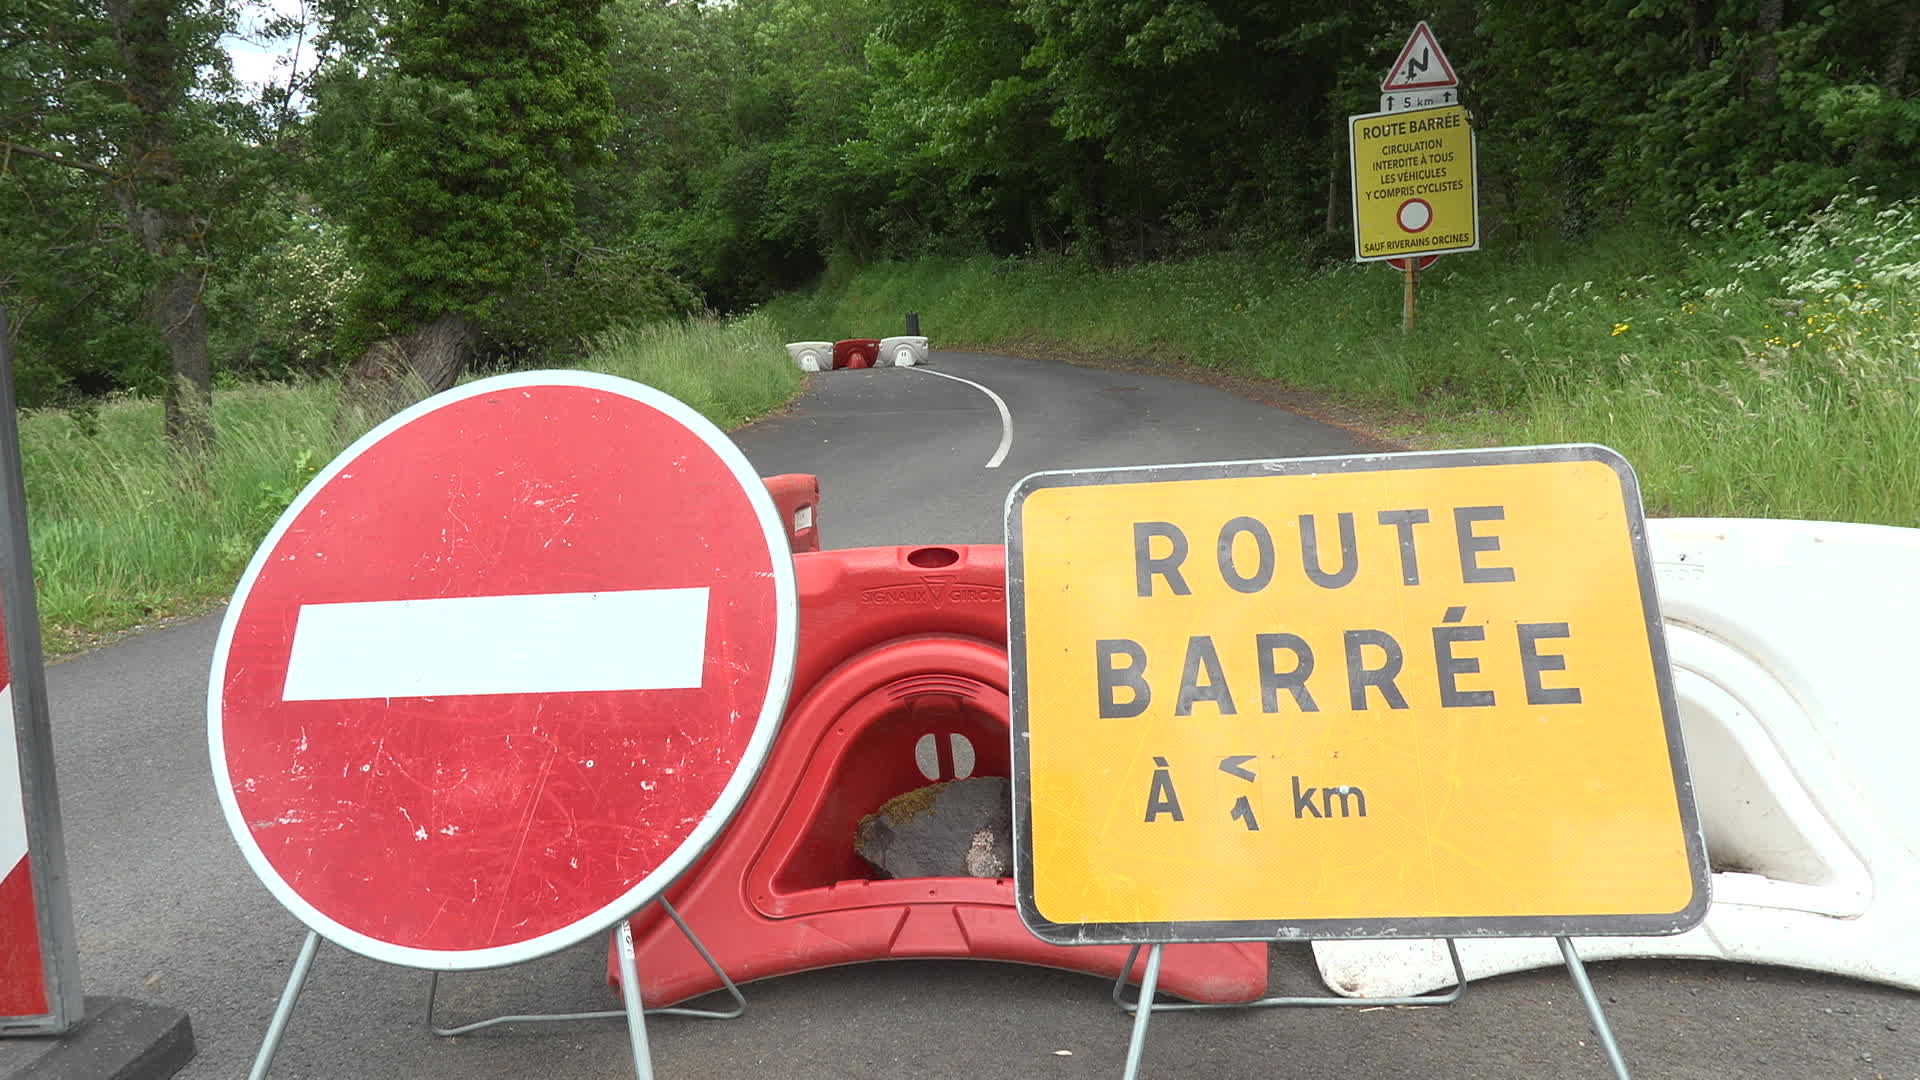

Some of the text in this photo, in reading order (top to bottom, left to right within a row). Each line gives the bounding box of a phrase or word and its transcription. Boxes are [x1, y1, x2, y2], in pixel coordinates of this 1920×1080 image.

[1403, 96, 1434, 109] 5 km
[1363, 111, 1461, 140] ROUTE BARRÉE
[1382, 138, 1443, 156] CIRCULATION
[1372, 151, 1455, 172] INTERDITE À TOUS
[1380, 167, 1447, 185] LES VÉHICULES
[1365, 180, 1464, 200] Y COMPRIS CYCLISTES
[1364, 232, 1470, 253] SAUF RIVERAINS ORCINES
[1133, 505, 1516, 598] ROUTE
[948, 589, 1004, 603] GIROD
[1096, 606, 1582, 719] BARRÉE
[1144, 756, 1185, 823] À
[1291, 776, 1367, 820] km
